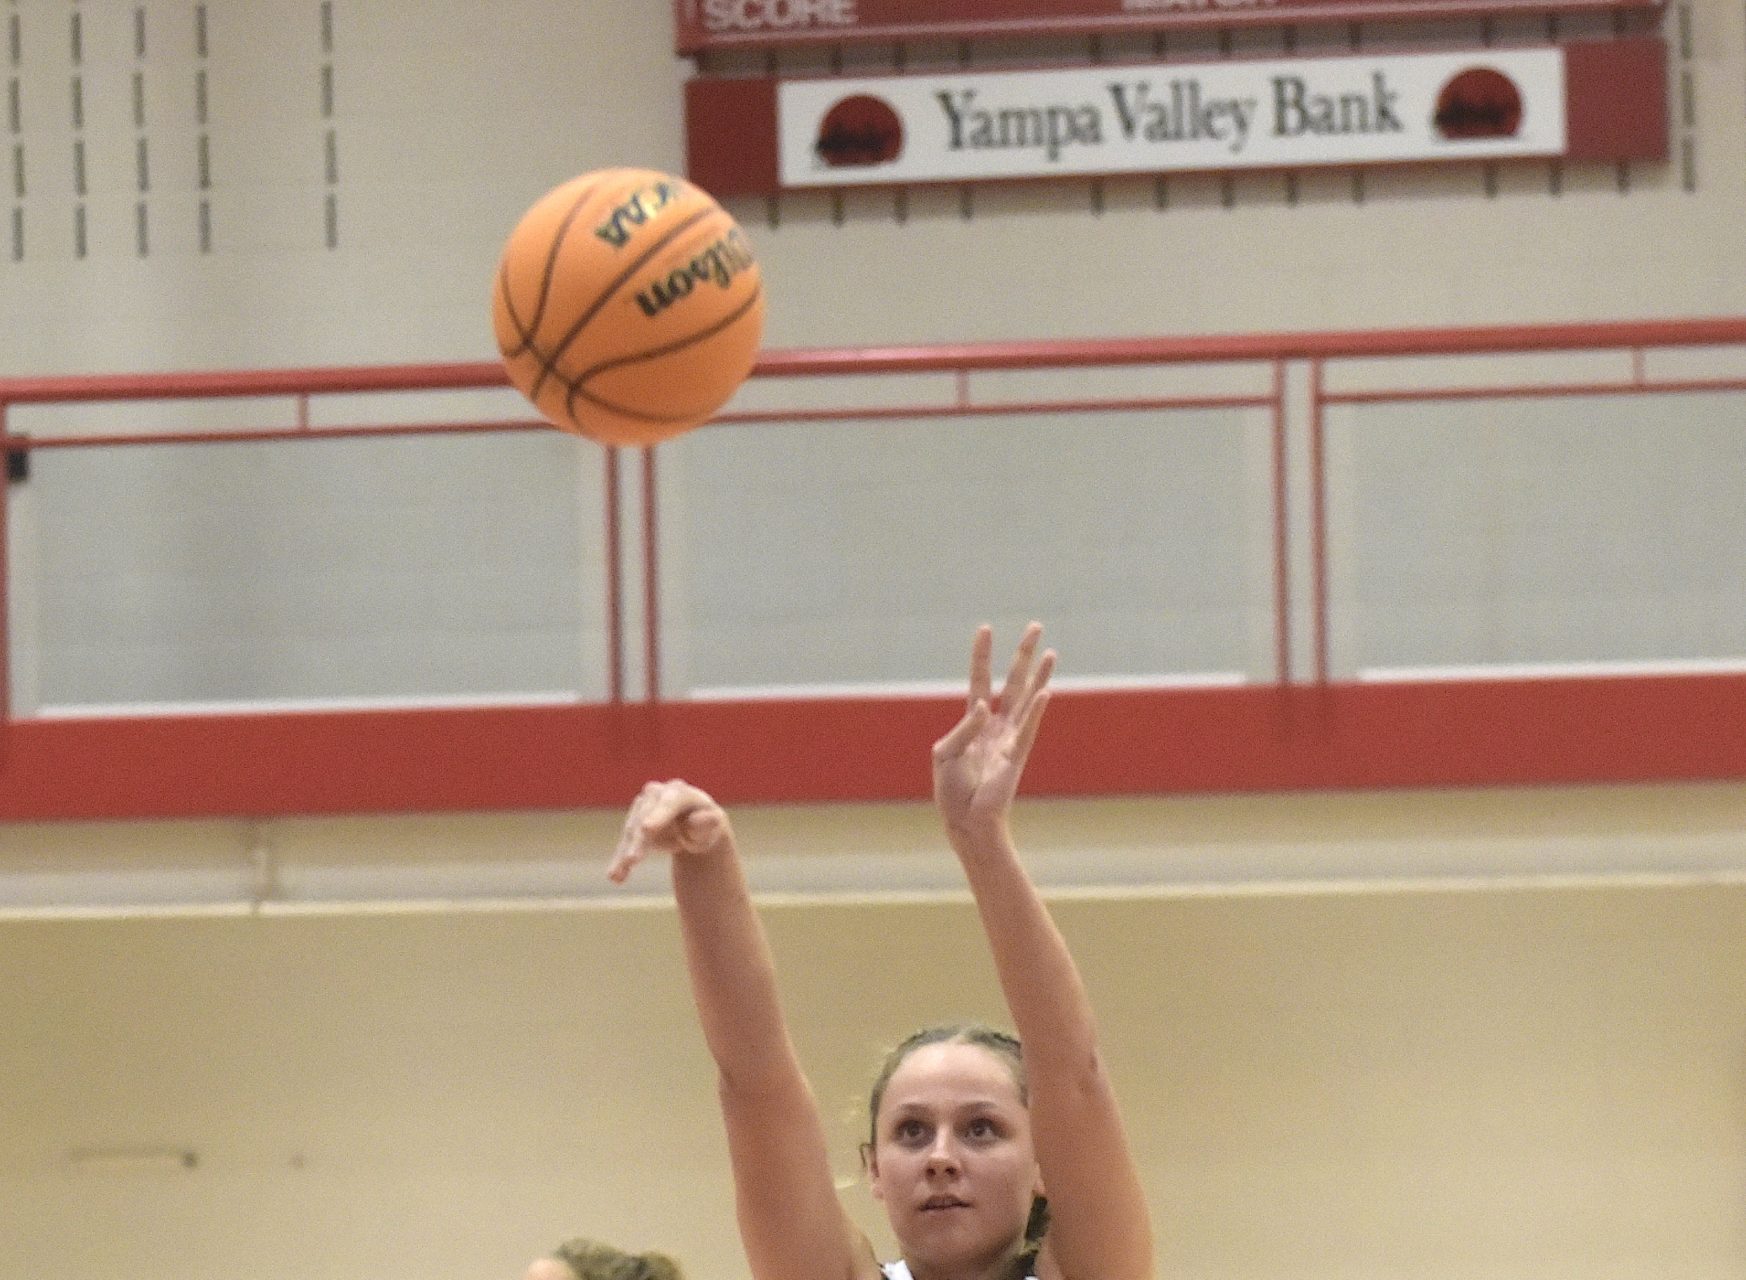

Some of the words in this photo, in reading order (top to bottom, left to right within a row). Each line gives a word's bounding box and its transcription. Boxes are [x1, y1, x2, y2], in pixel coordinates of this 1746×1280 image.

[934, 88, 1103, 162] Yampa
[1106, 78, 1256, 153] Valley
[1269, 70, 1403, 137] Bank
